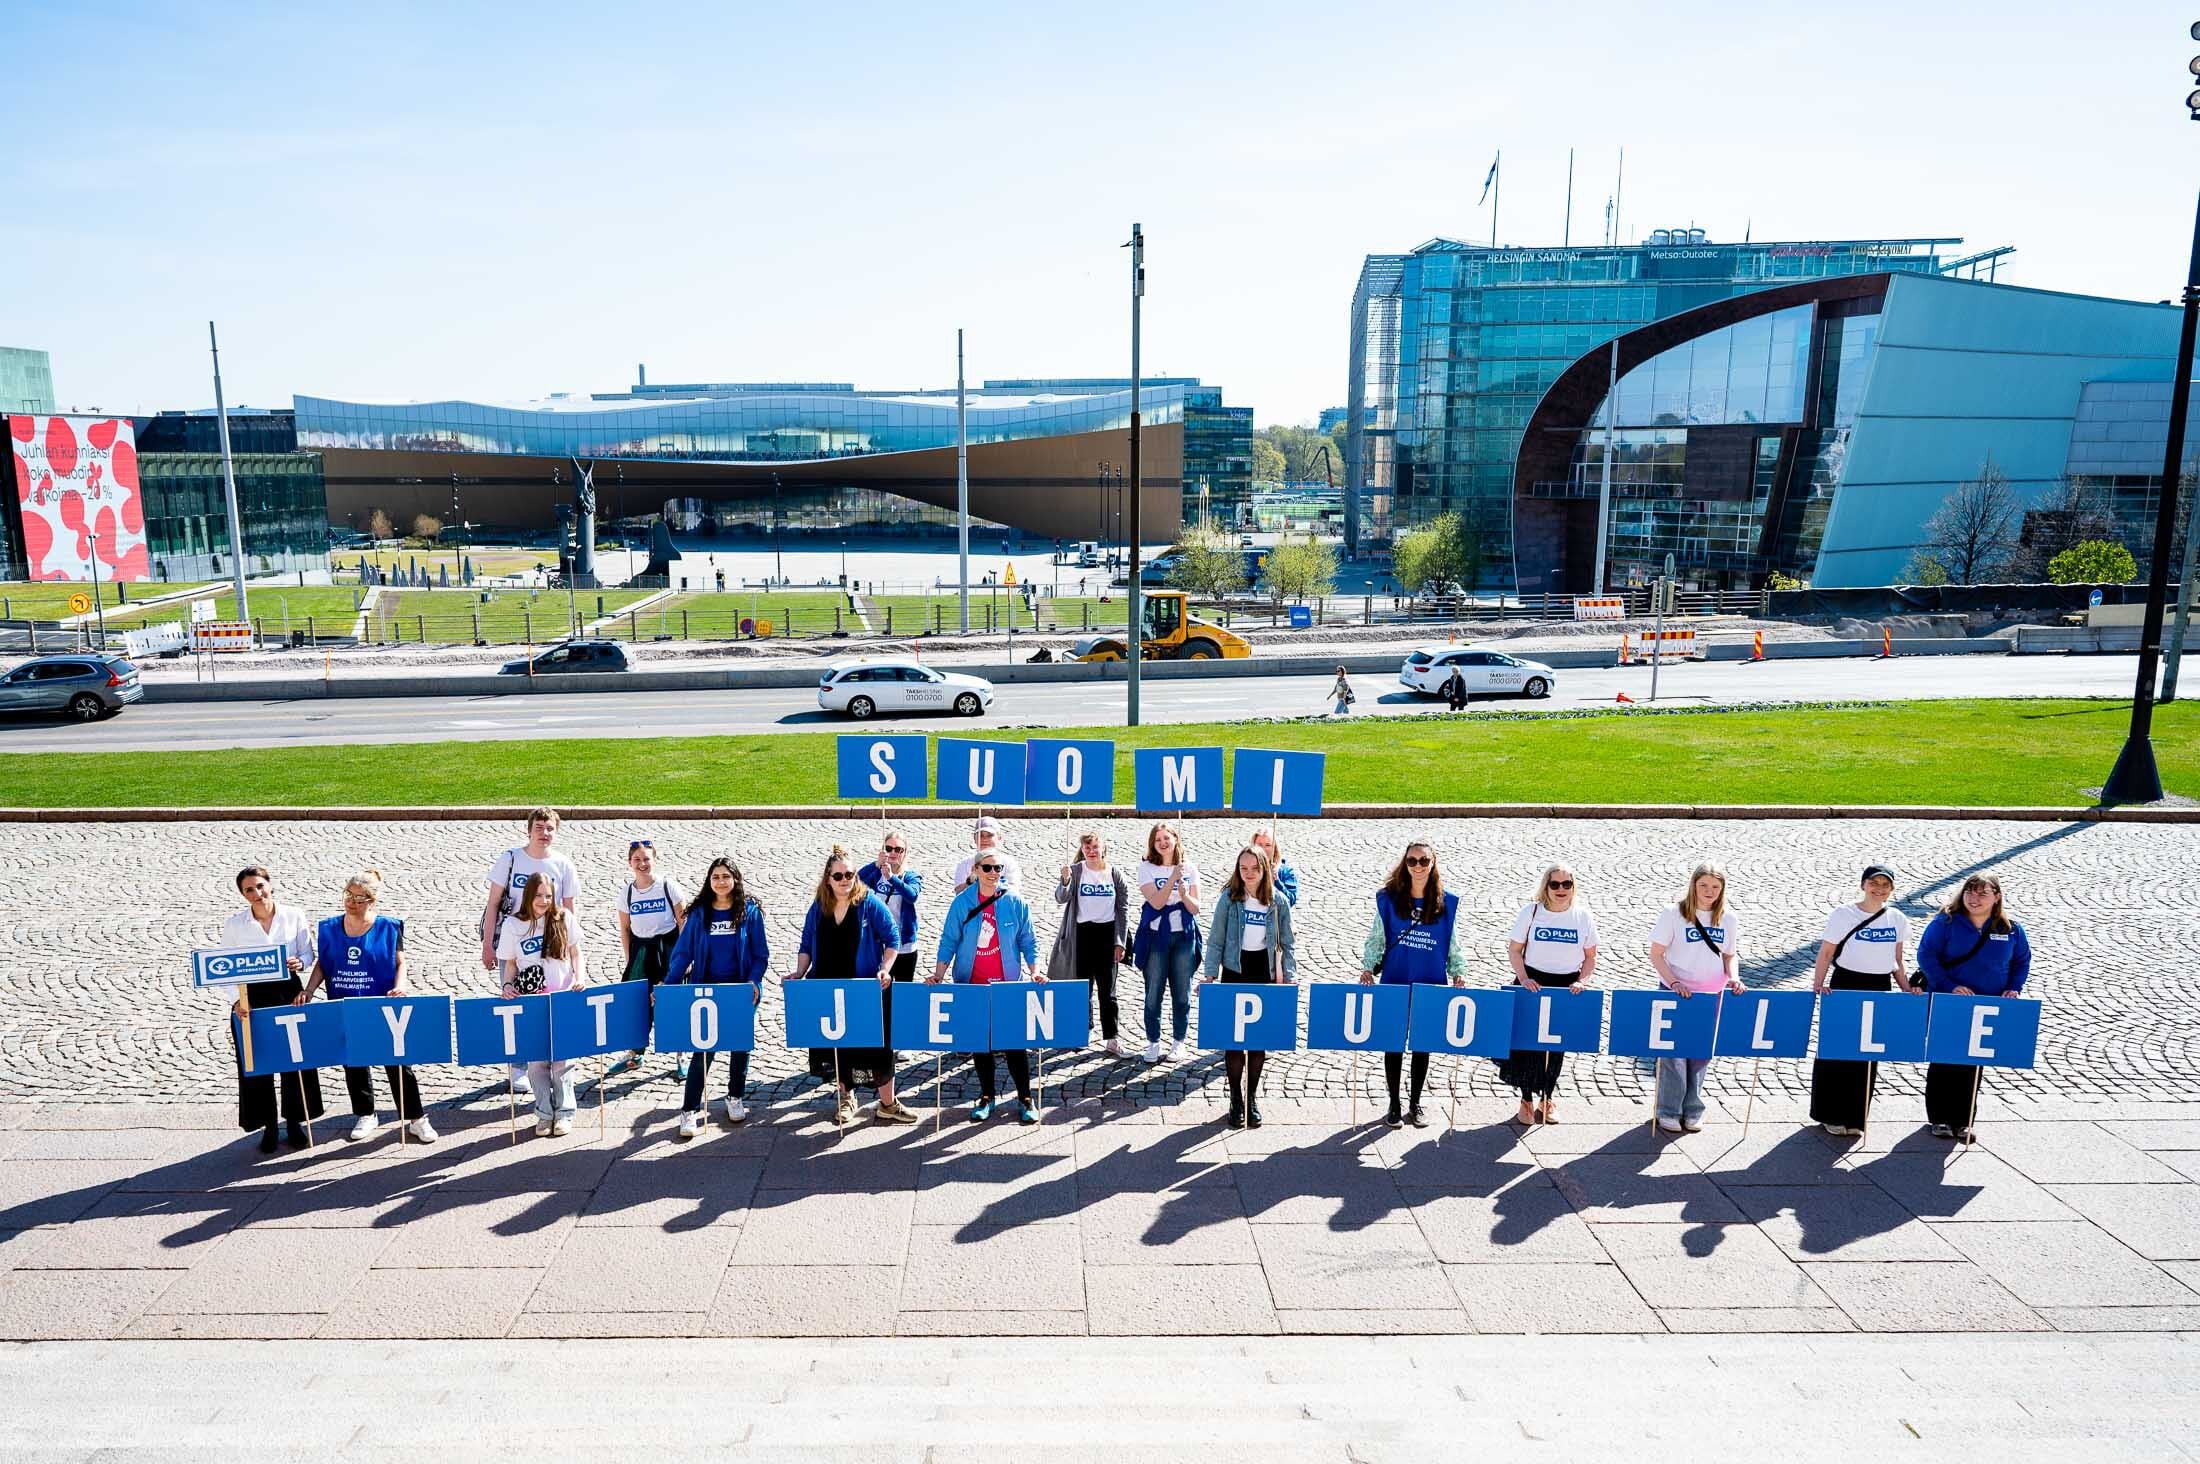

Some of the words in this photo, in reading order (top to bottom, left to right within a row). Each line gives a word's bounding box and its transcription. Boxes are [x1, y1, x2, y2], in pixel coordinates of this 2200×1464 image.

[1486, 252, 1535, 263] HELSINGIN
[1537, 252, 1582, 263] SANOMAT
[1650, 250, 1718, 260] Metso:Outotec
[22, 443, 58, 459] Juhlan
[61, 443, 111, 459] kunniaksi
[23, 465, 52, 481] koko
[54, 465, 92, 480] muodin
[642, 901, 665, 910] PLAN
[1247, 912, 1265, 921] PLA
[1552, 930, 1577, 939] PLAN
[1872, 930, 1896, 938] PLAN
[236, 954, 276, 968] PLAN
